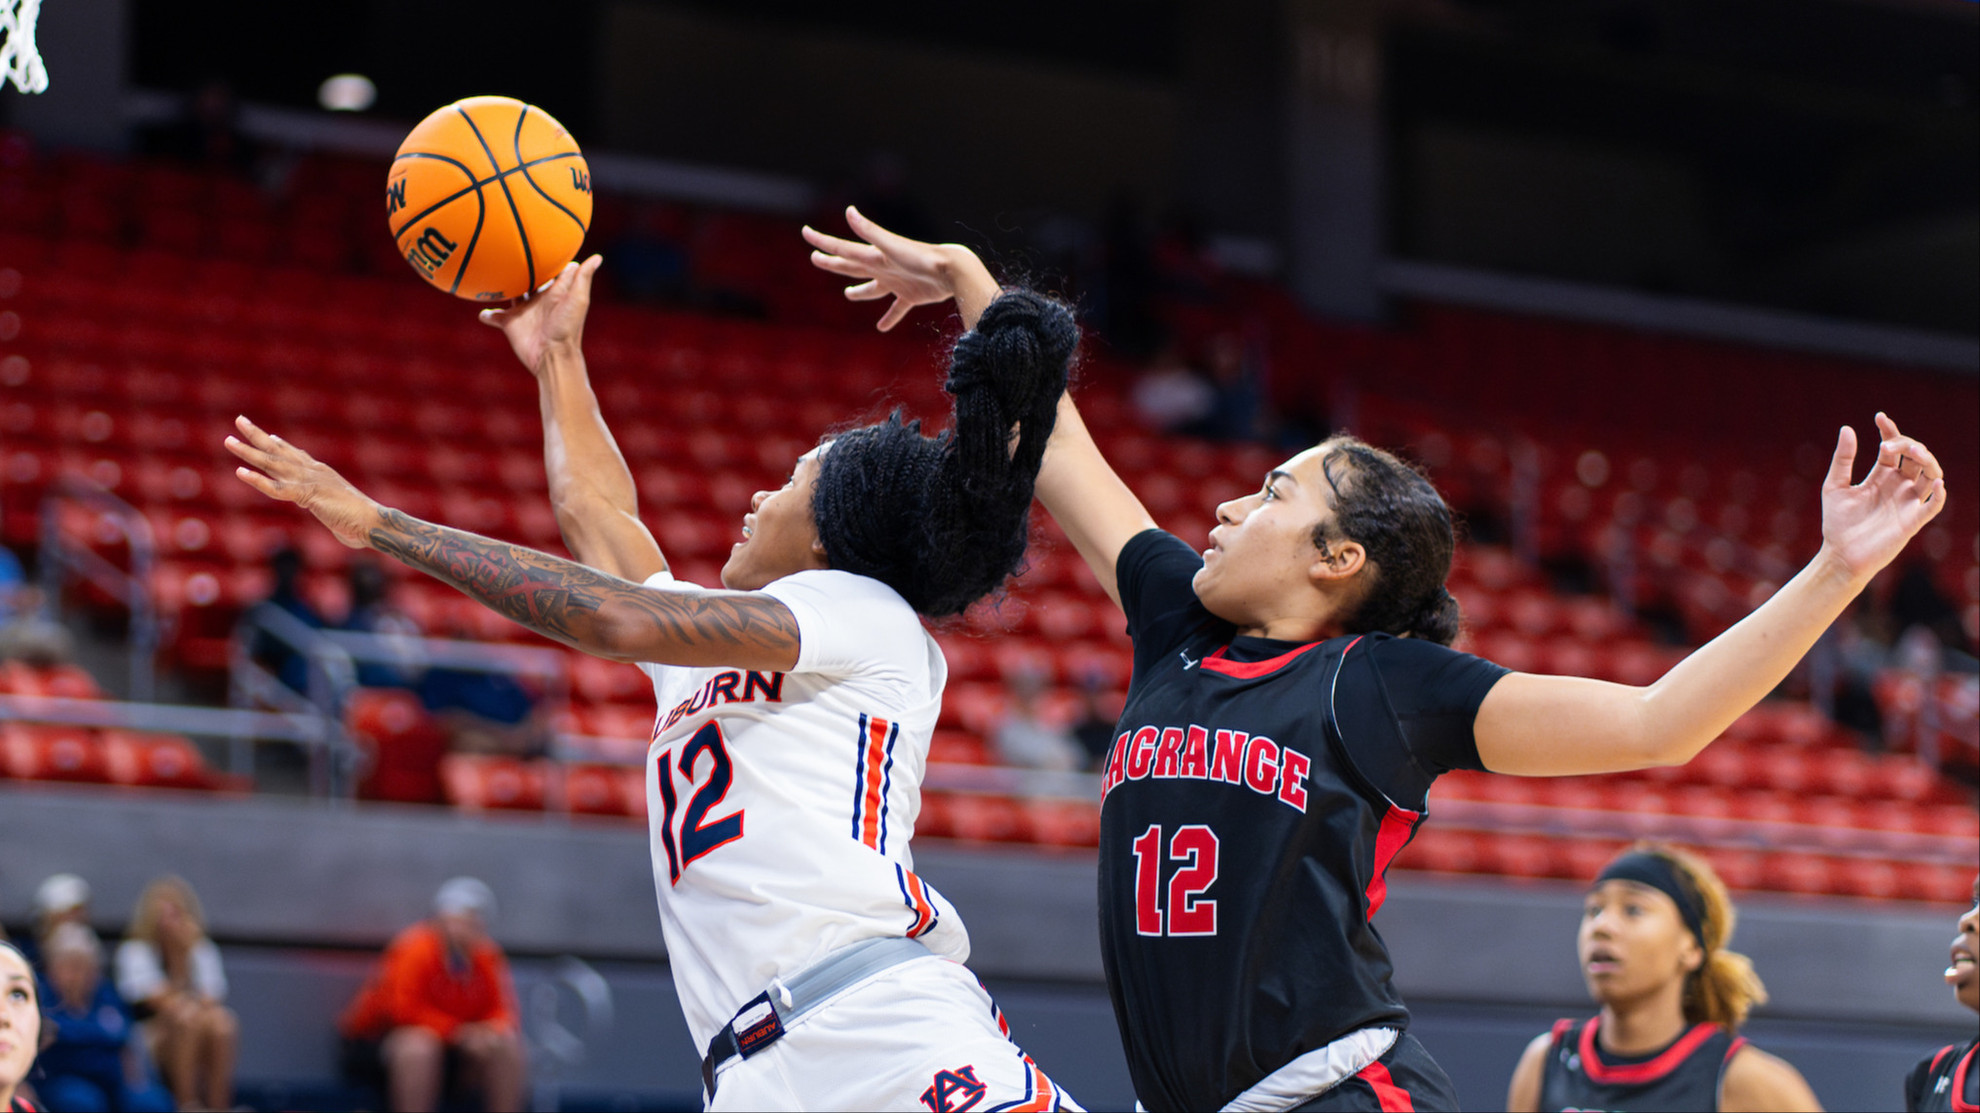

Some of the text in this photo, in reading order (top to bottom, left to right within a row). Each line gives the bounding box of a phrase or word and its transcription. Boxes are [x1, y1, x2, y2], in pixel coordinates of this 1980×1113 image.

[648, 668, 786, 745] UBURN
[657, 718, 745, 888] 12
[1133, 824, 1219, 937] 12
[741, 1021, 776, 1047] AUBURN
